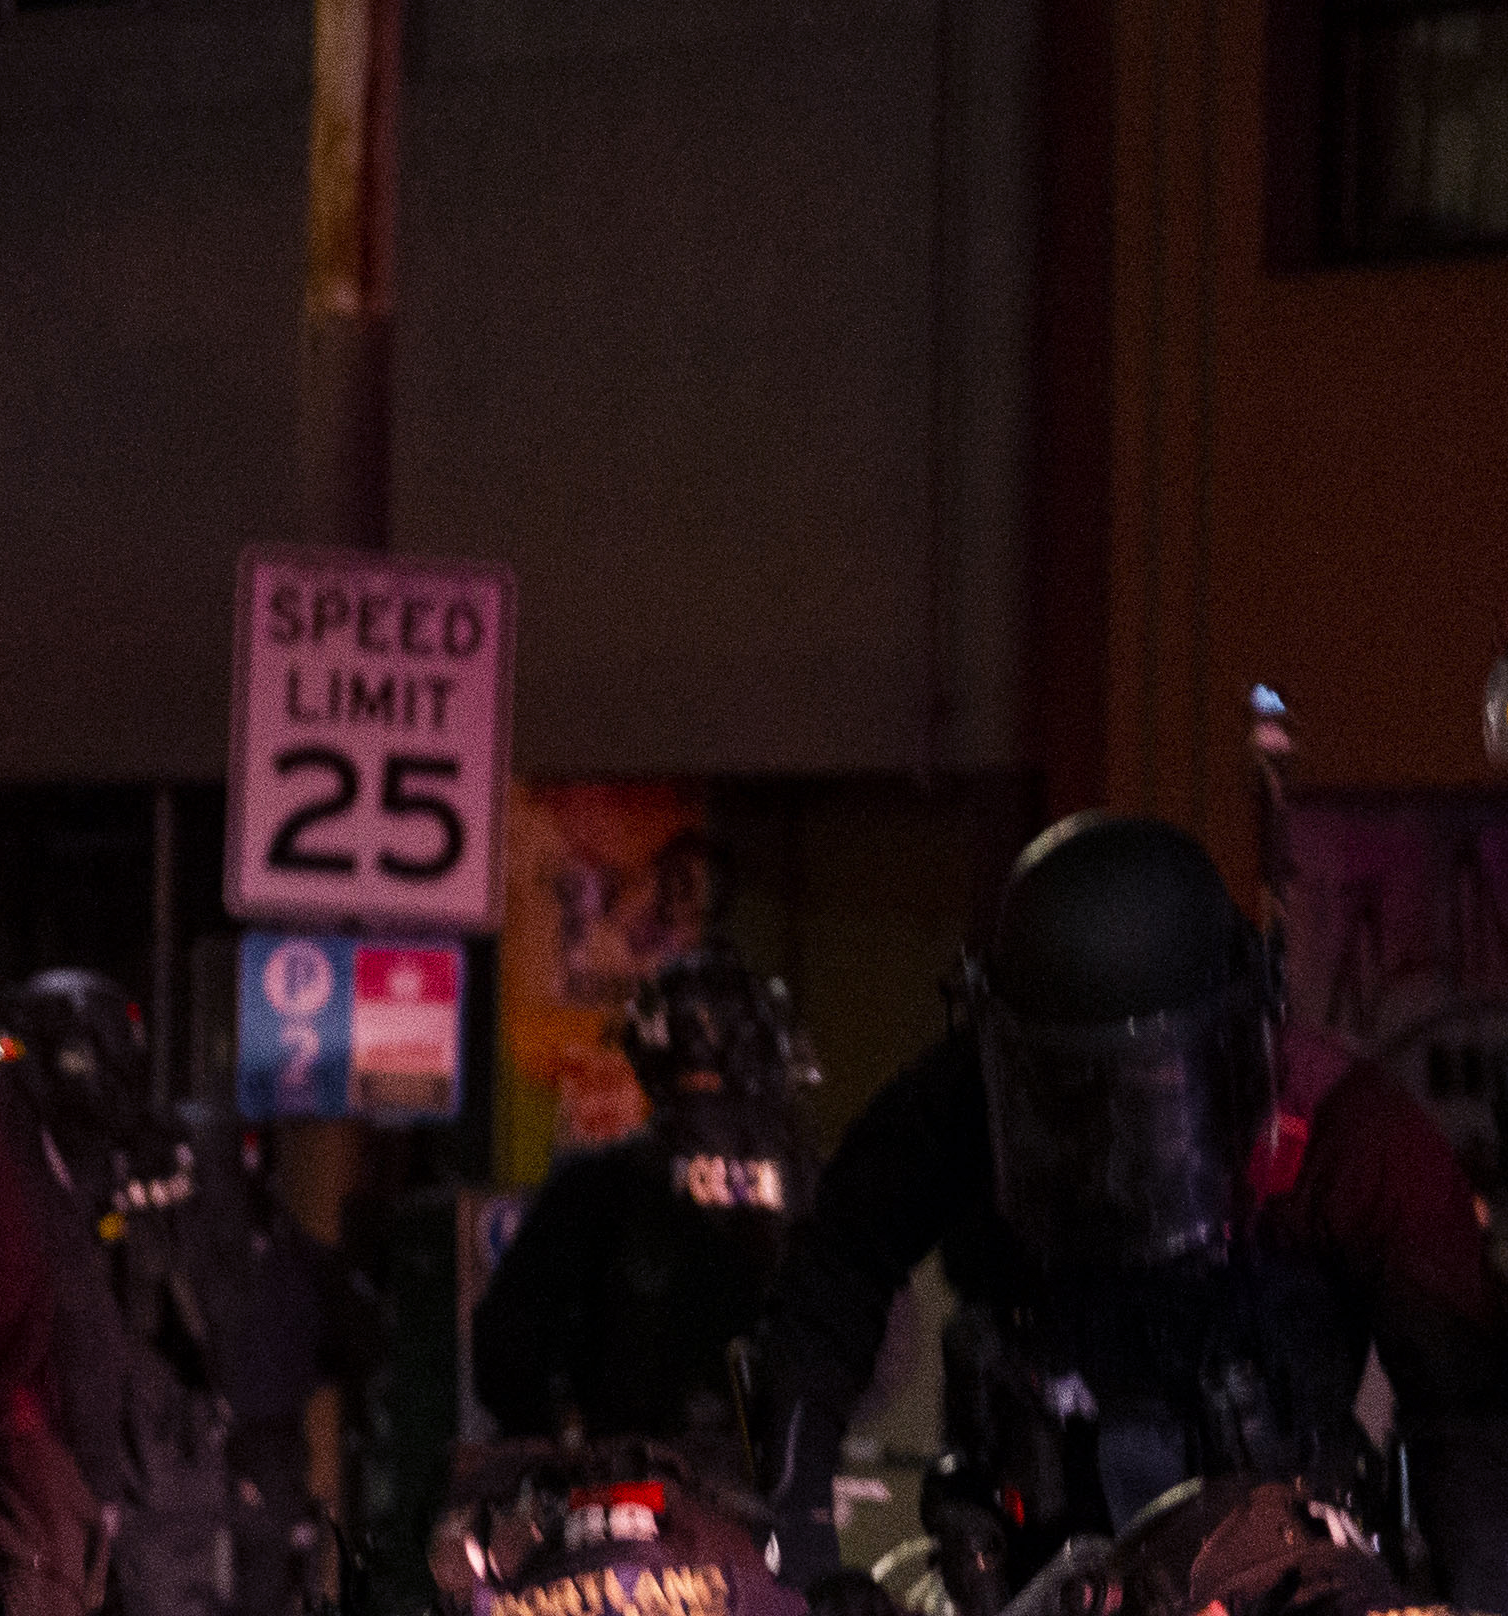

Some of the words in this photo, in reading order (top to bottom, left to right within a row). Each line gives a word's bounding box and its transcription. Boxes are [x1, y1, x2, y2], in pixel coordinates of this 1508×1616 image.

[269, 584, 483, 656] SPEED
[286, 666, 455, 728] LIMIT
[267, 743, 464, 882] 25
